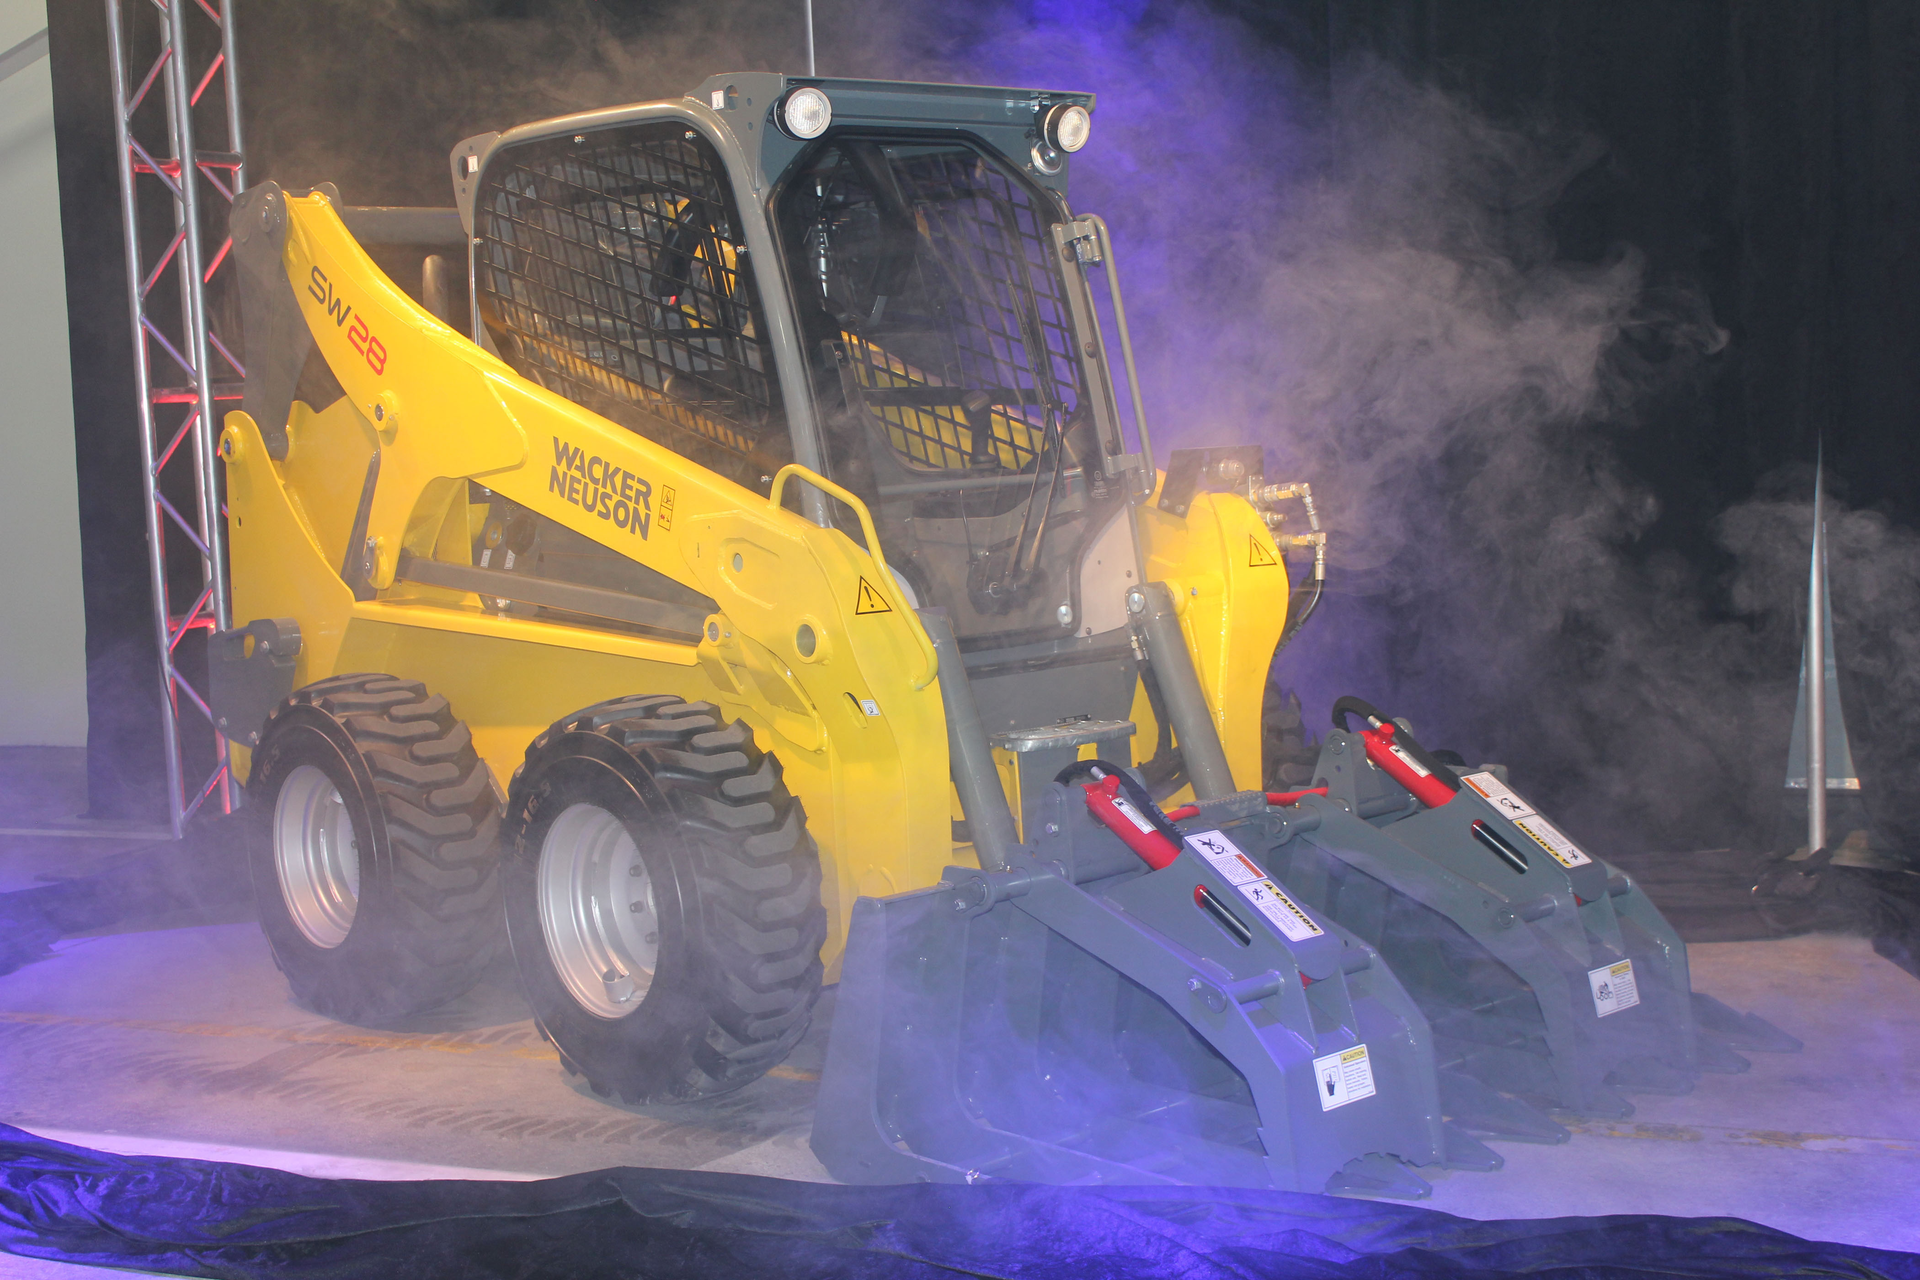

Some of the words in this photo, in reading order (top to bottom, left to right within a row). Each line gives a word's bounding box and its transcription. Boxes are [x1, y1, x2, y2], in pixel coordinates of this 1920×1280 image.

[548, 464, 651, 542] NEUSON
[552, 435, 652, 513] WACKER
[1519, 822, 1560, 857] CAUTION
[1275, 891, 1318, 932] CAUTION
